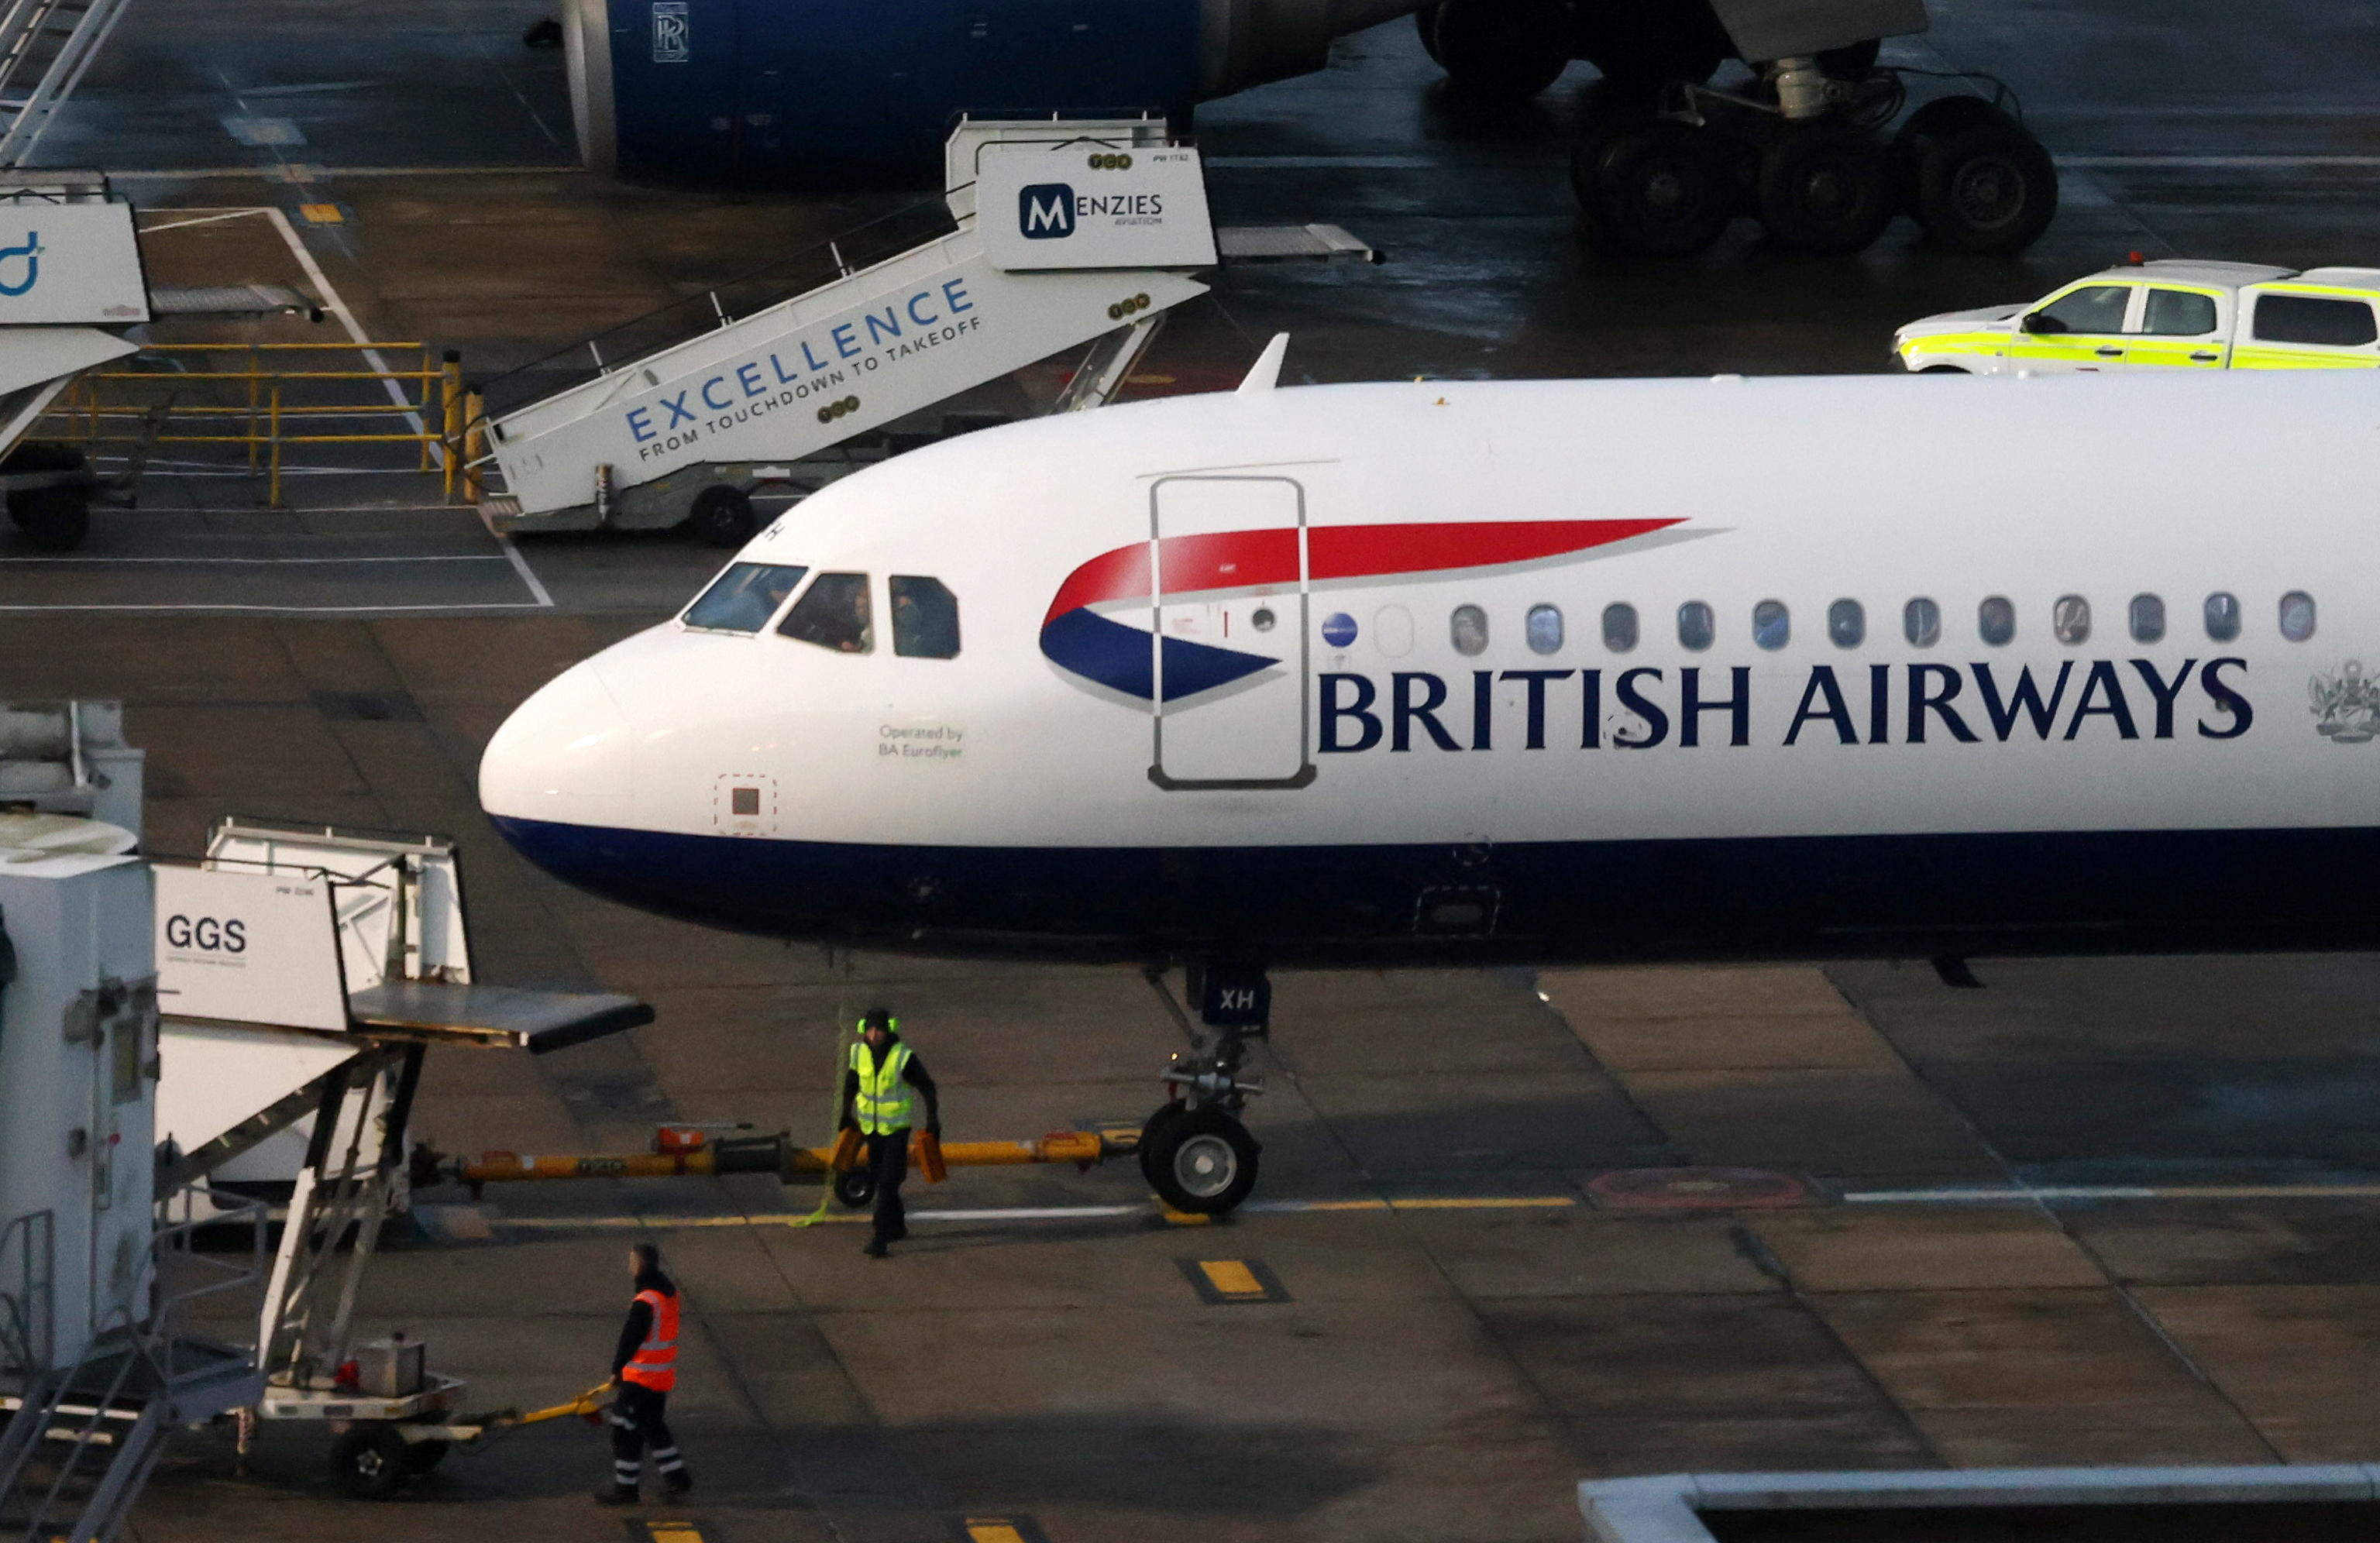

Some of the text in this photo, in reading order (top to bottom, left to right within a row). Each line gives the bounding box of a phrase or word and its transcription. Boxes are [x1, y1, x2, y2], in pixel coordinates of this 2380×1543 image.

[1027, 194, 1162, 232] MENZIES
[1115, 217, 1162, 226] AVIATION
[625, 277, 973, 442] EXCELLENCE
[638, 429, 699, 462] FROM
[706, 369, 846, 435] TOUCHDOWN
[851, 356, 878, 377] TO
[886, 316, 982, 363] TAKEOFF
[1317, 657, 2253, 753] BRITISH AIRWAYS
[879, 724, 963, 742] Operated by
[879, 743, 963, 759] BA Euroflyer
[167, 914, 246, 953] GGS
[1220, 989, 1254, 1009] XH
